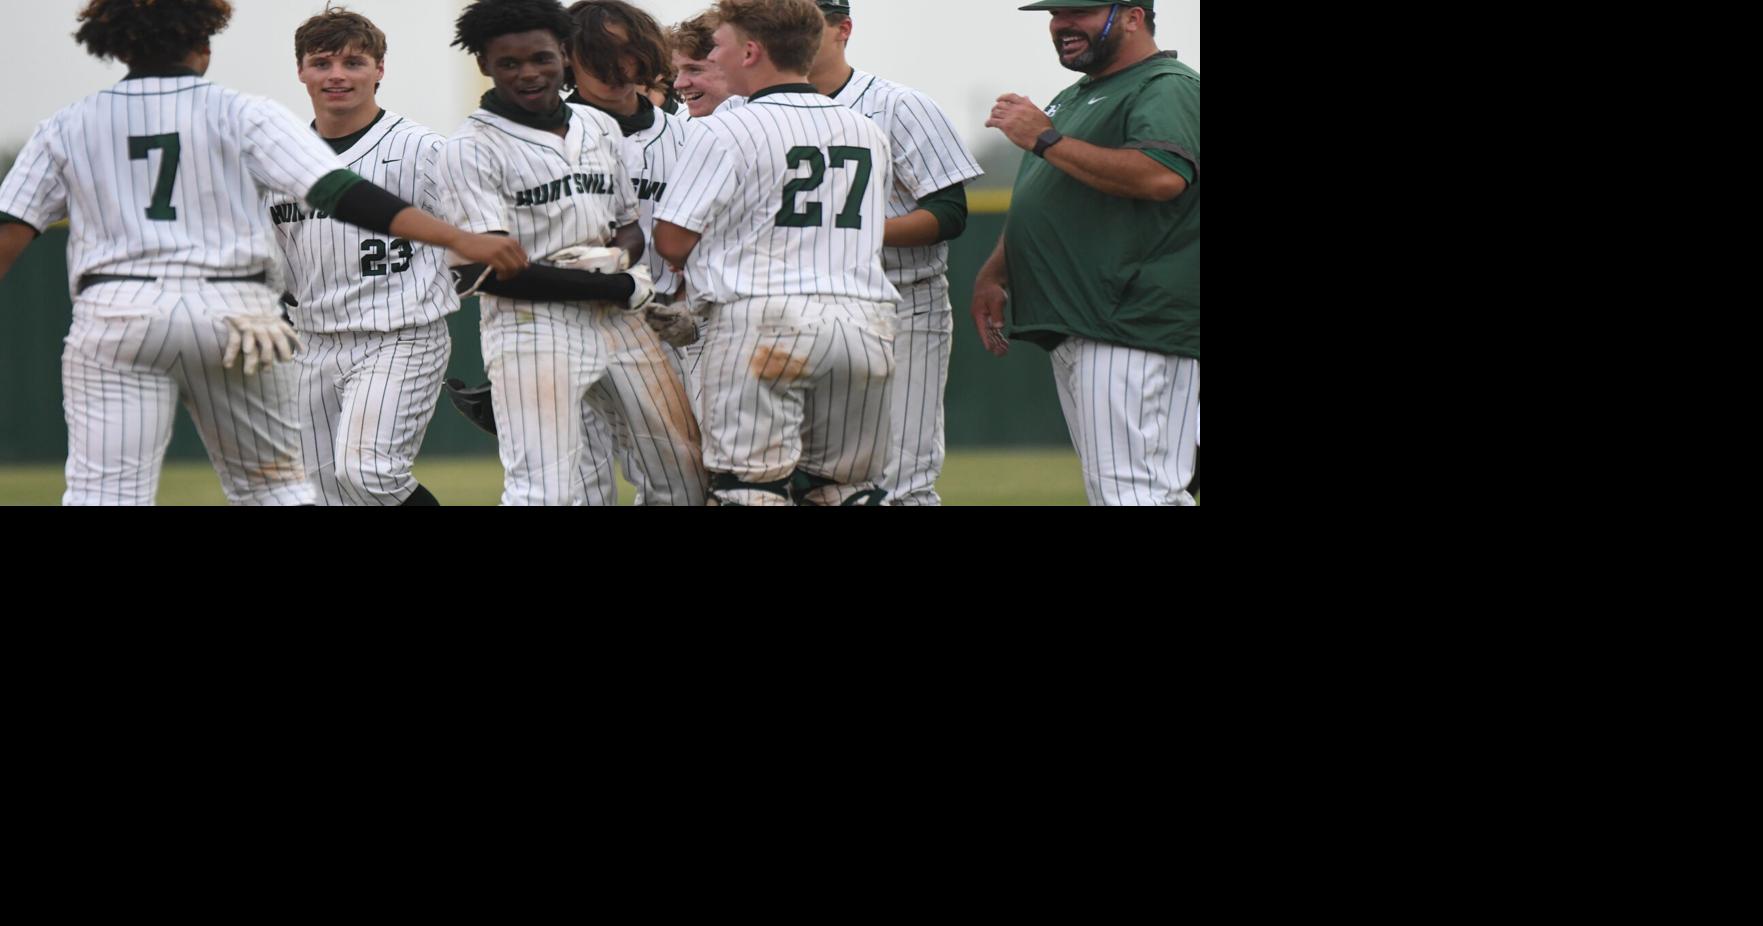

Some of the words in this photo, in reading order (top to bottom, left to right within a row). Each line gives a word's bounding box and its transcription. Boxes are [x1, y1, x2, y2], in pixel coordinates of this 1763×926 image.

[127, 132, 181, 221] 7
[775, 145, 872, 230] 27
[360, 237, 413, 277] 23
